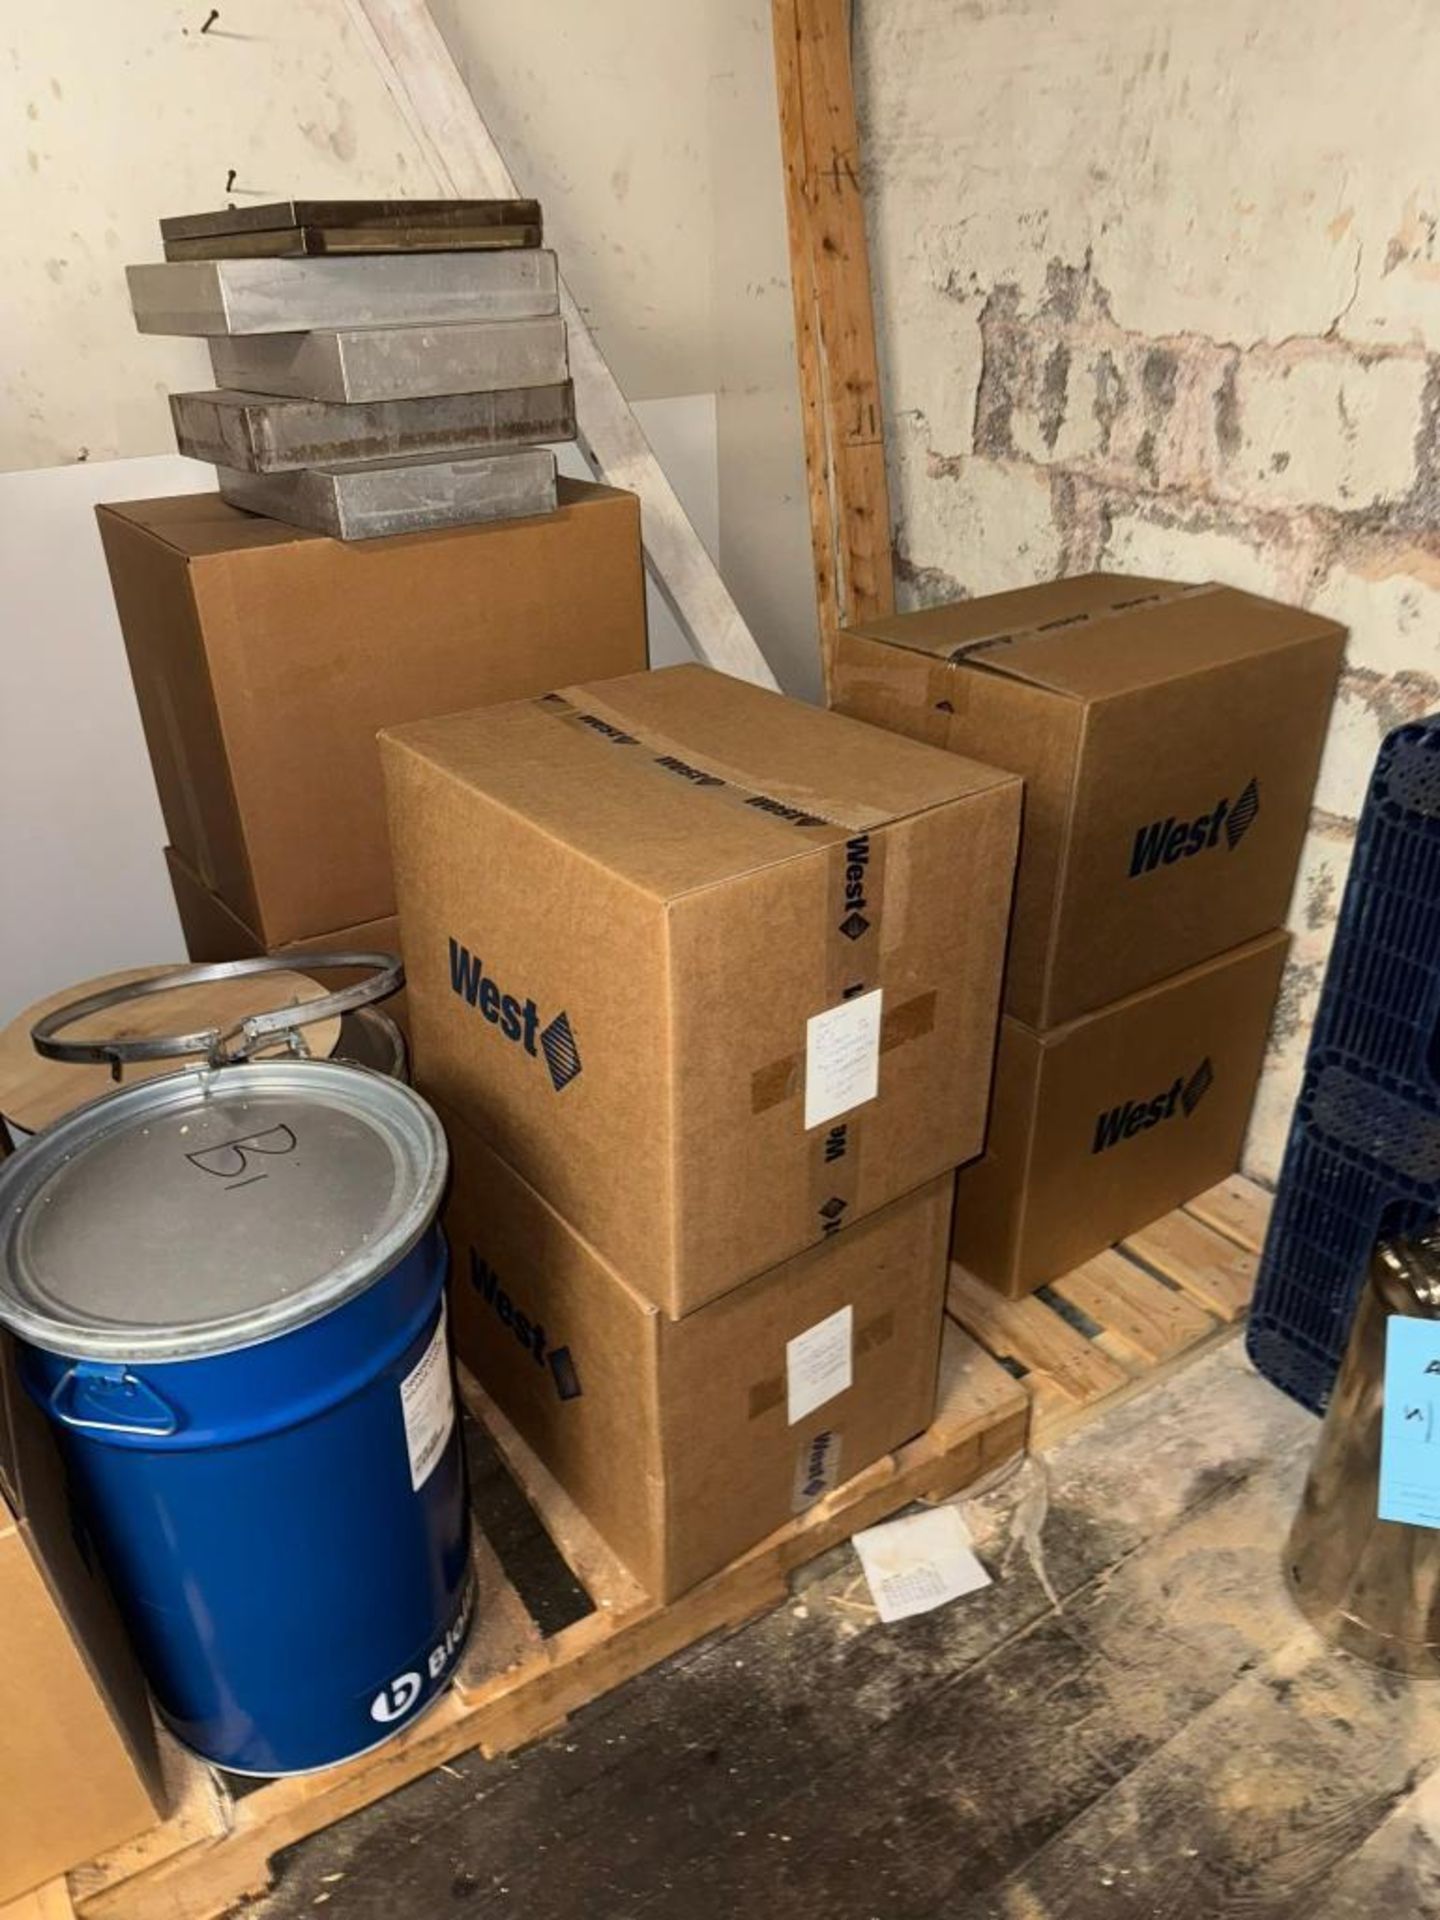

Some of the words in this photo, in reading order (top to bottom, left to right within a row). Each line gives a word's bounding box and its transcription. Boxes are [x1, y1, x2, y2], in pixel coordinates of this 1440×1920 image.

[845, 834, 869, 912] West
[1128, 799, 1229, 878] West
[449, 937, 539, 1058] West
[1092, 1077, 1184, 1154] West
[469, 1245, 546, 1368] West
